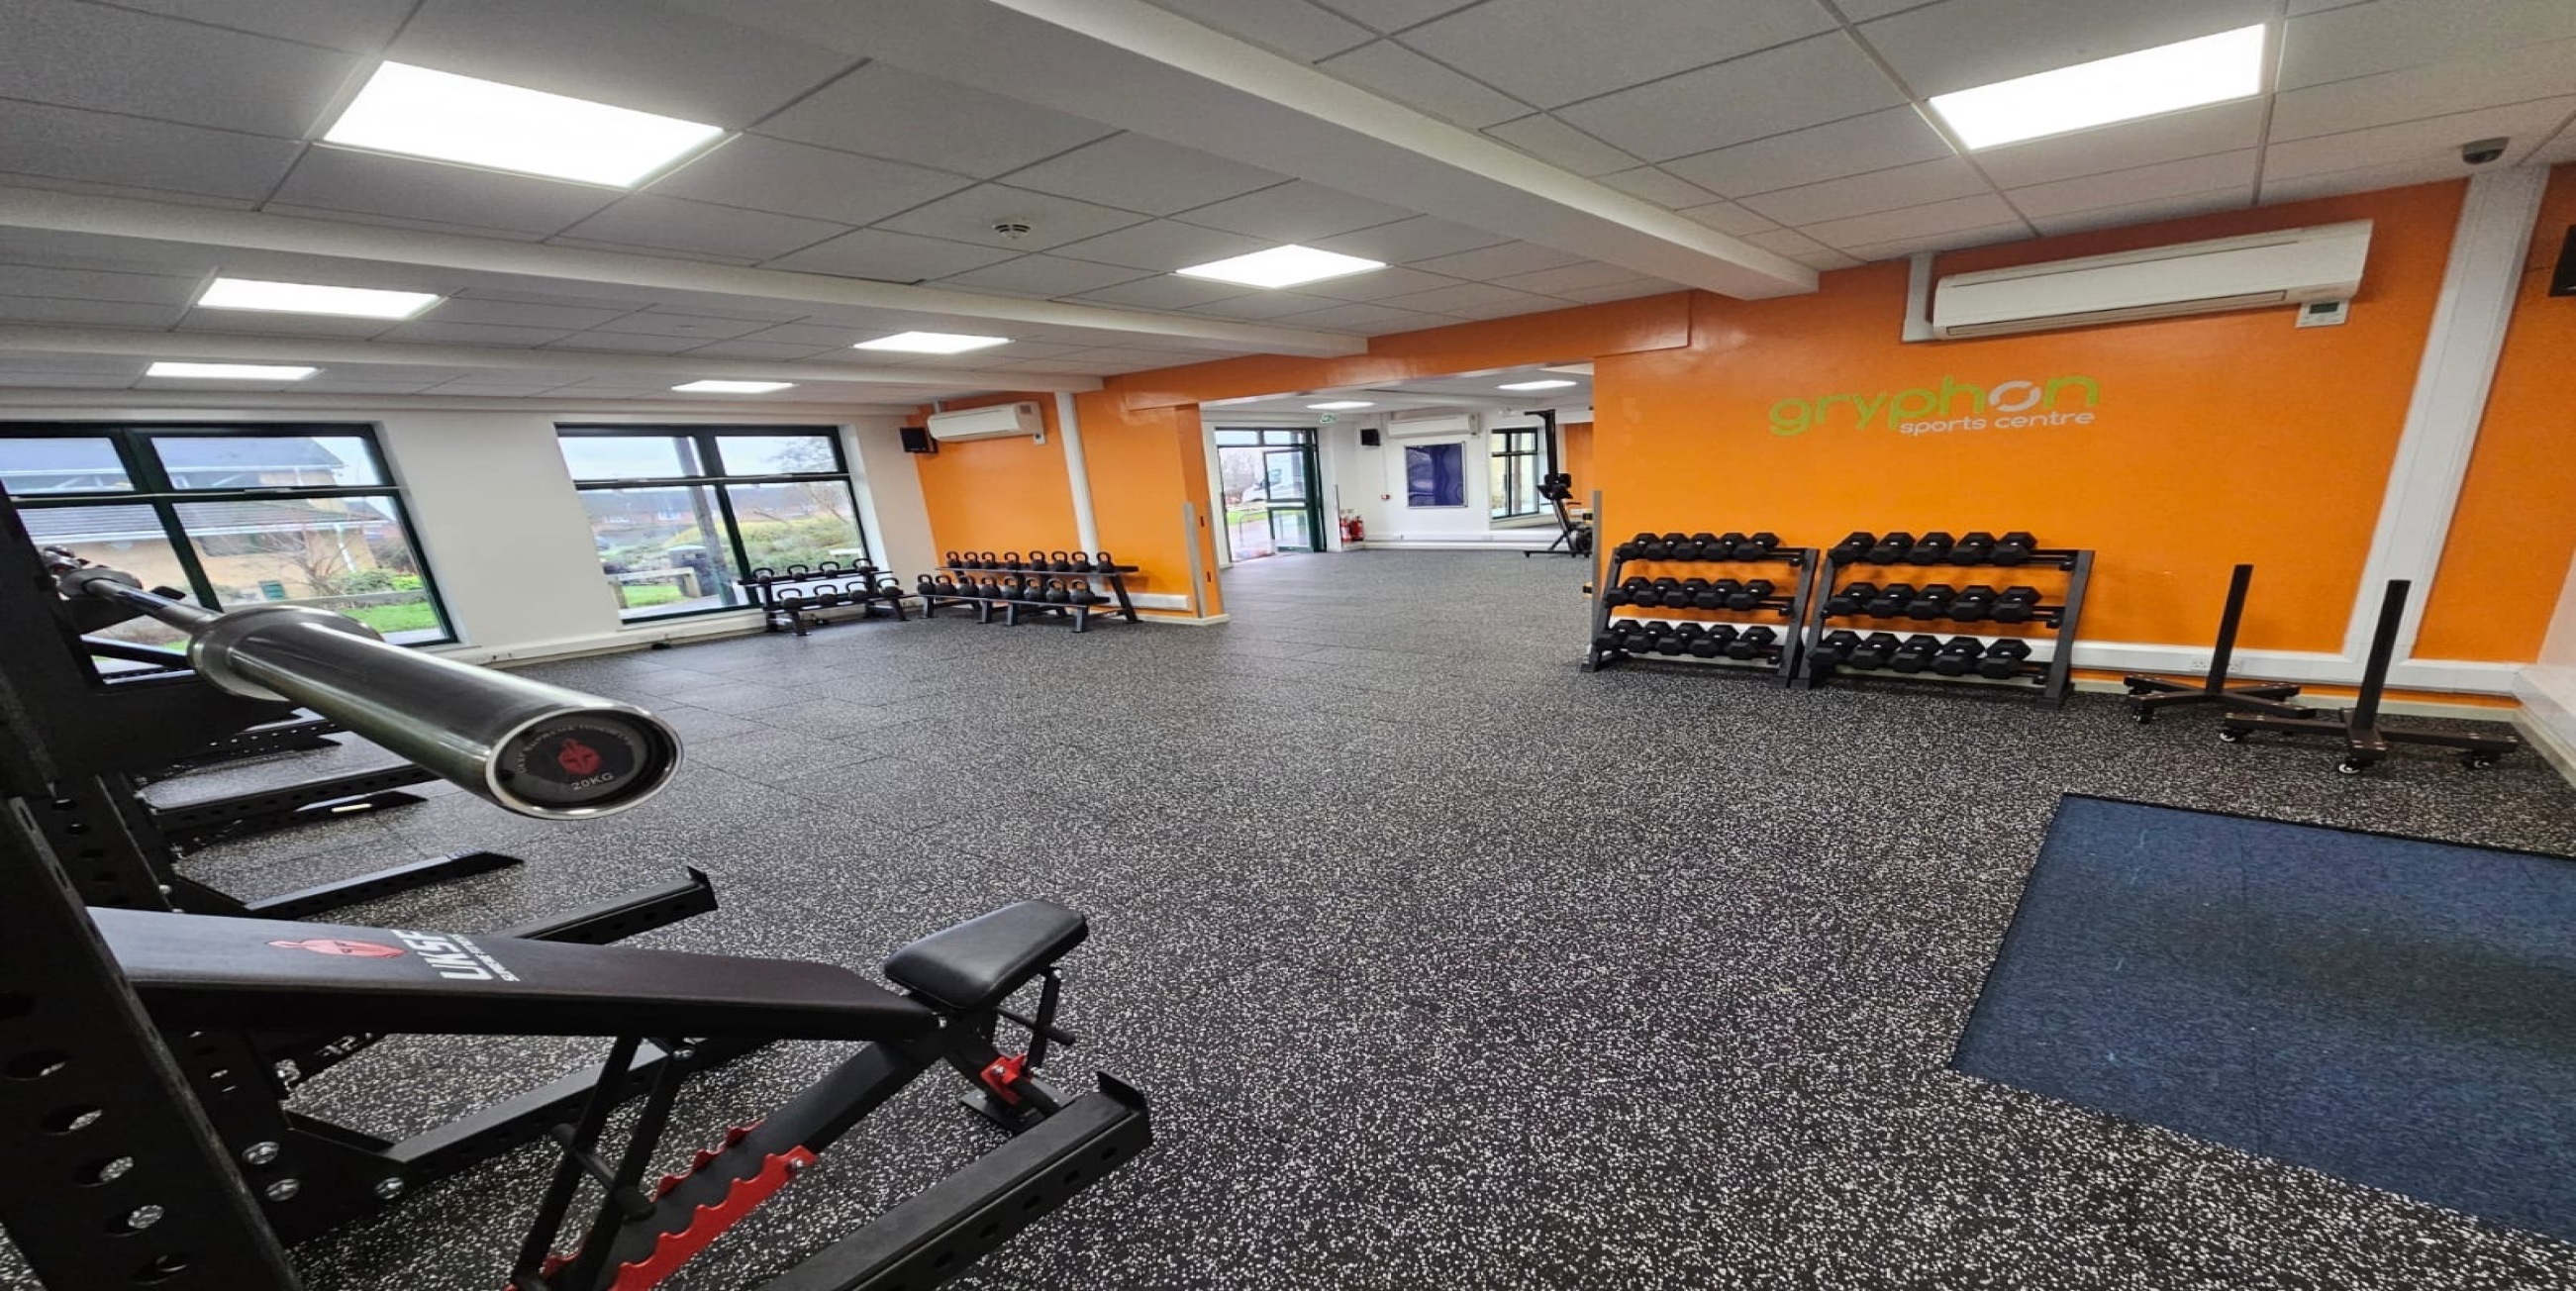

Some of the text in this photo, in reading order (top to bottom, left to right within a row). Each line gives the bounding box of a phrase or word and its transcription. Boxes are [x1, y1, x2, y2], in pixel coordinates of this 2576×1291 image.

[1769, 374, 2101, 437] gryphon
[1899, 410, 2096, 437] sports centre
[570, 772, 615, 791] 20KG
